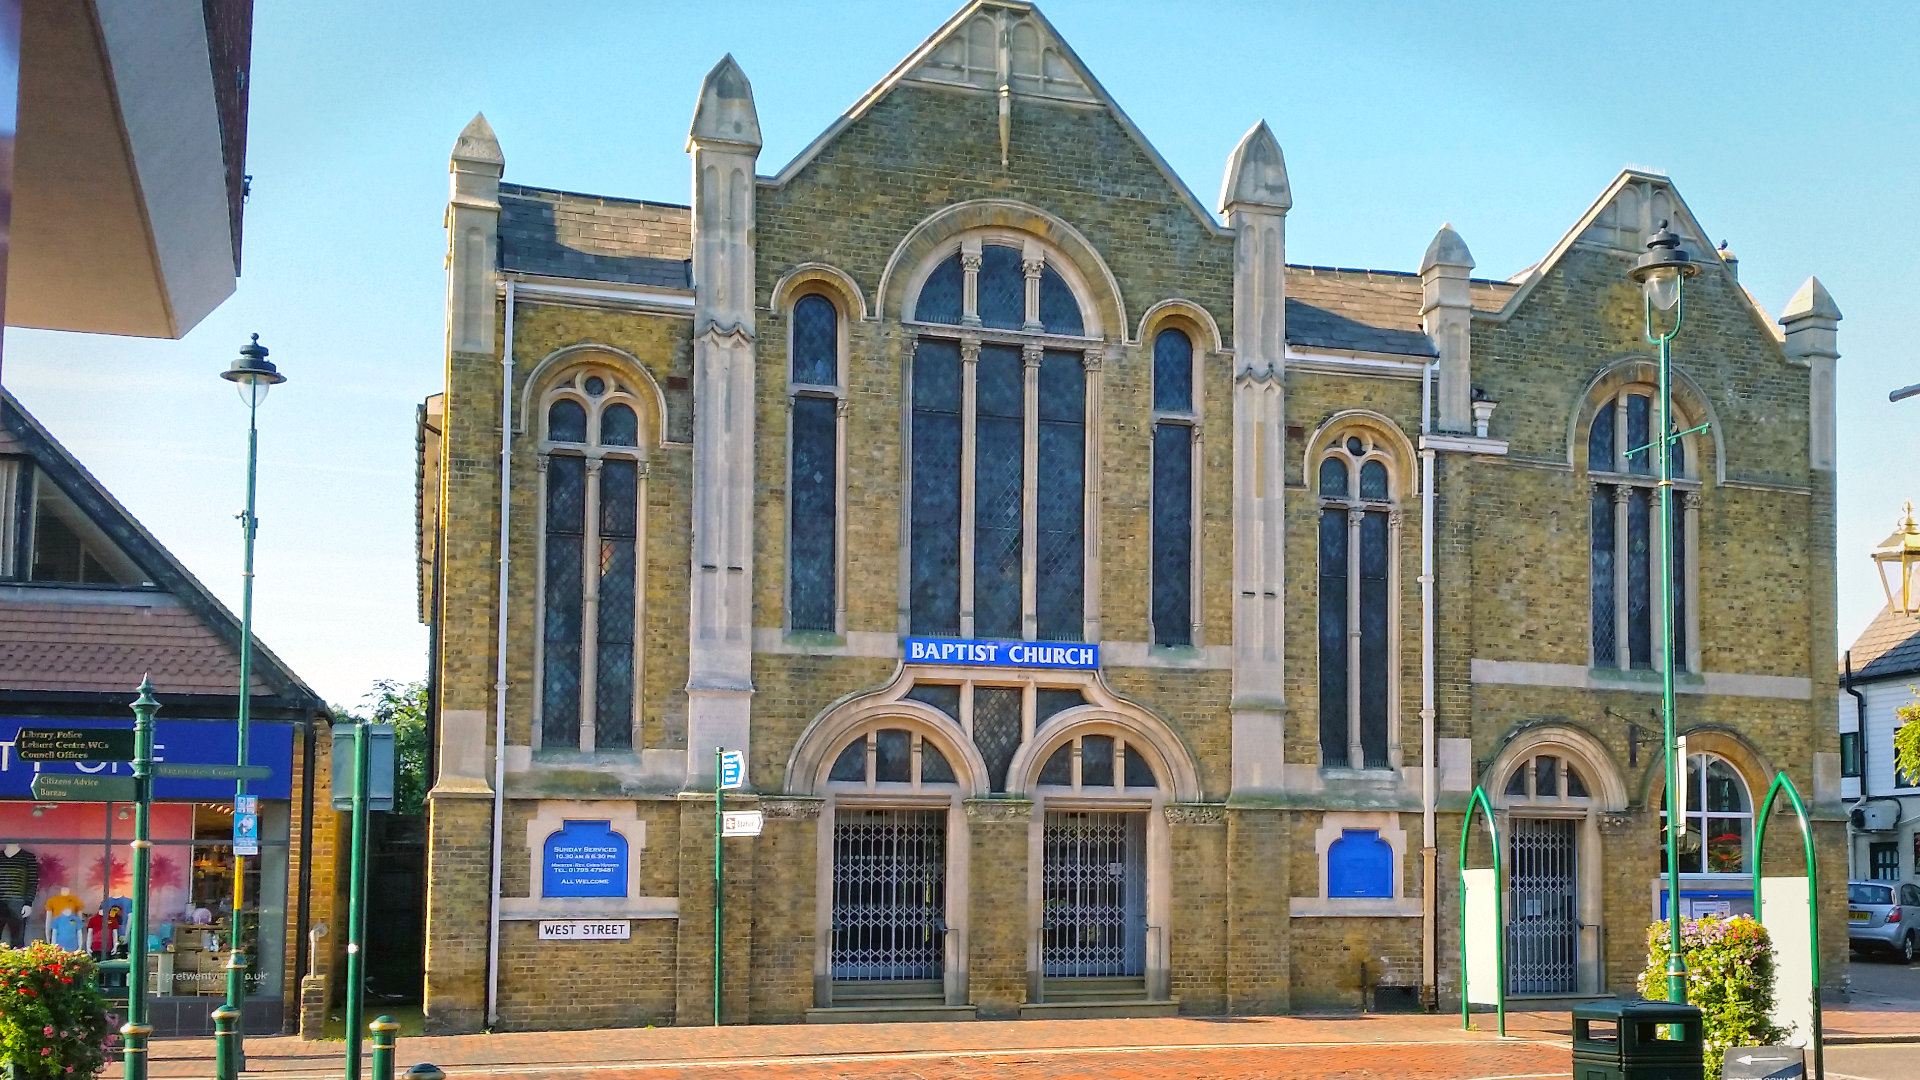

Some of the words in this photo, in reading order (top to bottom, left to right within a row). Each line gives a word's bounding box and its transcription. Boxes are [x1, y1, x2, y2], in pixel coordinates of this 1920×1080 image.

[911, 642, 999, 662] BAPTIST
[1008, 645, 1094, 665] CHURCH
[56, 730, 83, 739] Police
[21, 740, 54, 749] Leisure
[20, 750, 55, 759] Council
[56, 751, 89, 759] Offices
[40, 776, 72, 785] Citizens
[73, 777, 99, 786] Advice
[544, 924, 577, 935] WEST
[582, 924, 626, 935] STREET
